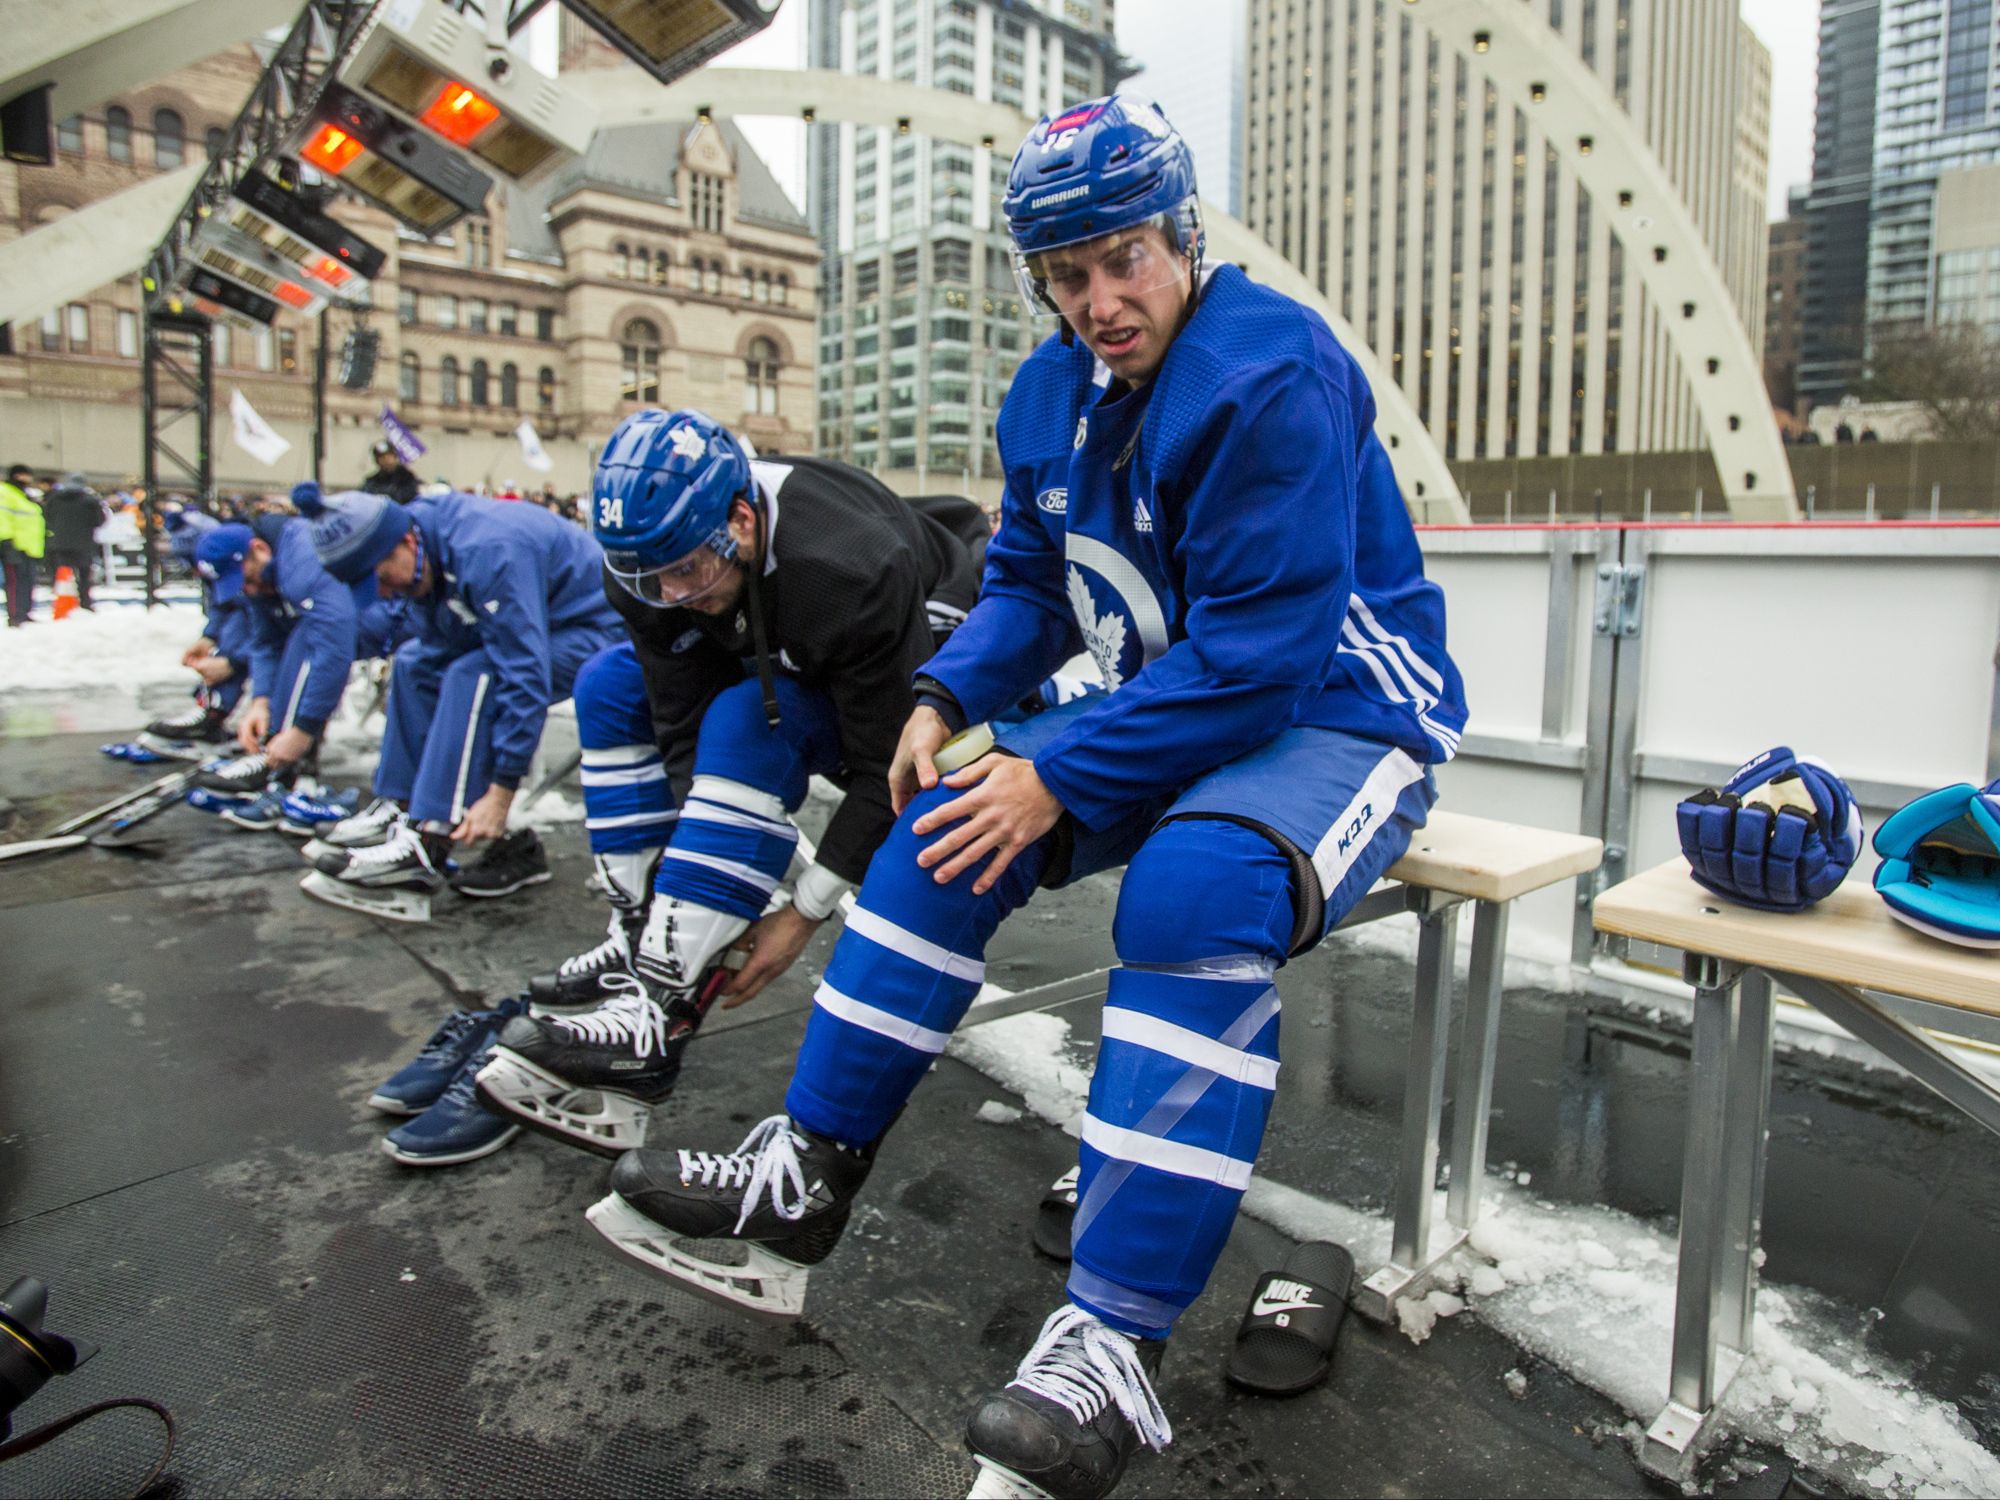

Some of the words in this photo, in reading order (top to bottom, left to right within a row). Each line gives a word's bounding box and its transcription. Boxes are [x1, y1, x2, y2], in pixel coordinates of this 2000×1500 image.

[1041, 127, 1080, 154] 16
[1031, 184, 1090, 210] WARRIOR
[1046, 491, 1068, 509] For
[599, 498, 624, 529] 34
[1337, 803, 1374, 857] CCM
[1263, 1279, 1313, 1304] NIKE
